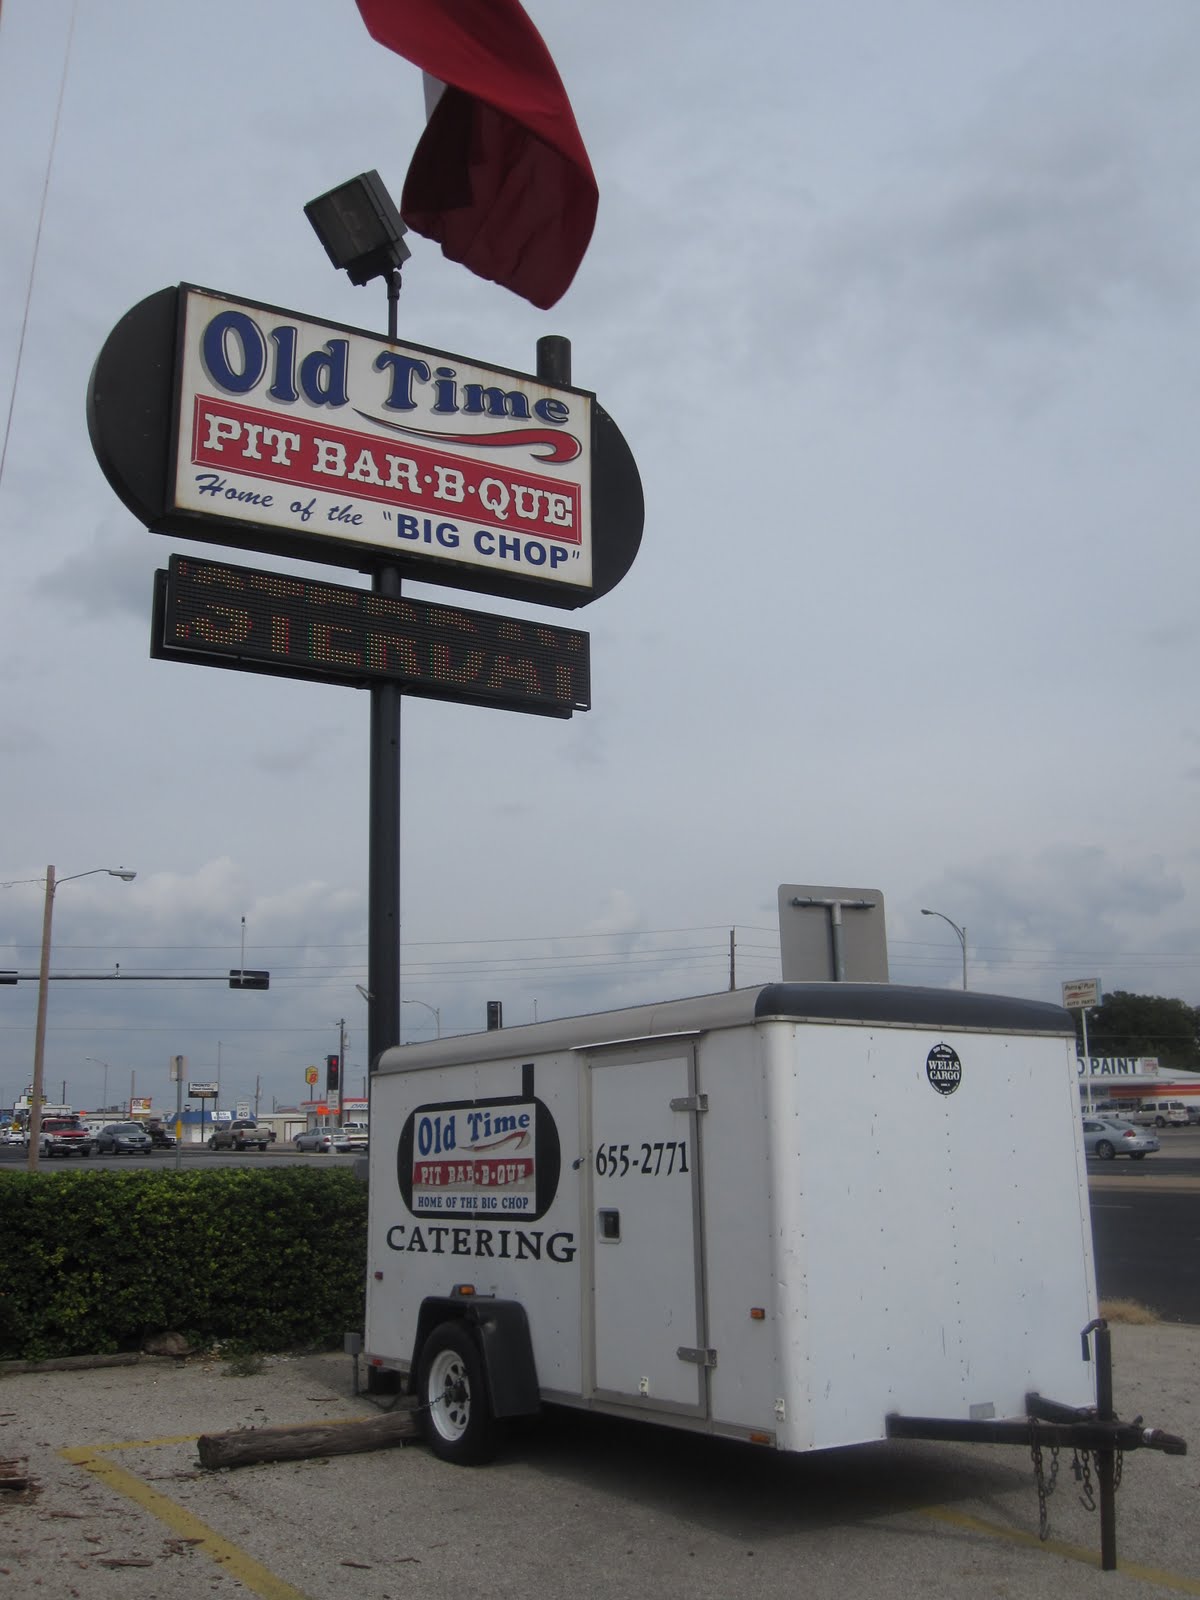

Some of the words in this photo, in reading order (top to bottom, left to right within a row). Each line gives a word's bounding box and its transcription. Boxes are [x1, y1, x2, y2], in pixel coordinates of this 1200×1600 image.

[203, 310, 350, 407] Old
[373, 350, 570, 424] Time
[203, 413, 301, 467] PIT
[194, 473, 274, 508] Home
[289, 490, 316, 521] of
[327, 504, 363, 526] the
[928, 1060, 960, 1070] WELLS
[930, 1070, 960, 1081] CARGO
[1090, 1057, 1138, 1075] PAINT
[418, 1116, 456, 1156] Old
[467, 1111, 531, 1142] Time
[421, 1166, 442, 1185] PIT
[596, 1141, 689, 1178] 655-2771
[418, 1196, 442, 1208] HOME
[446, 1196, 457, 1209] OF
[460, 1197, 479, 1209] THE
[481, 1197, 497, 1209] BIG
[502, 1197, 529, 1209] CHOP
[386, 1225, 577, 1263] CATERING
